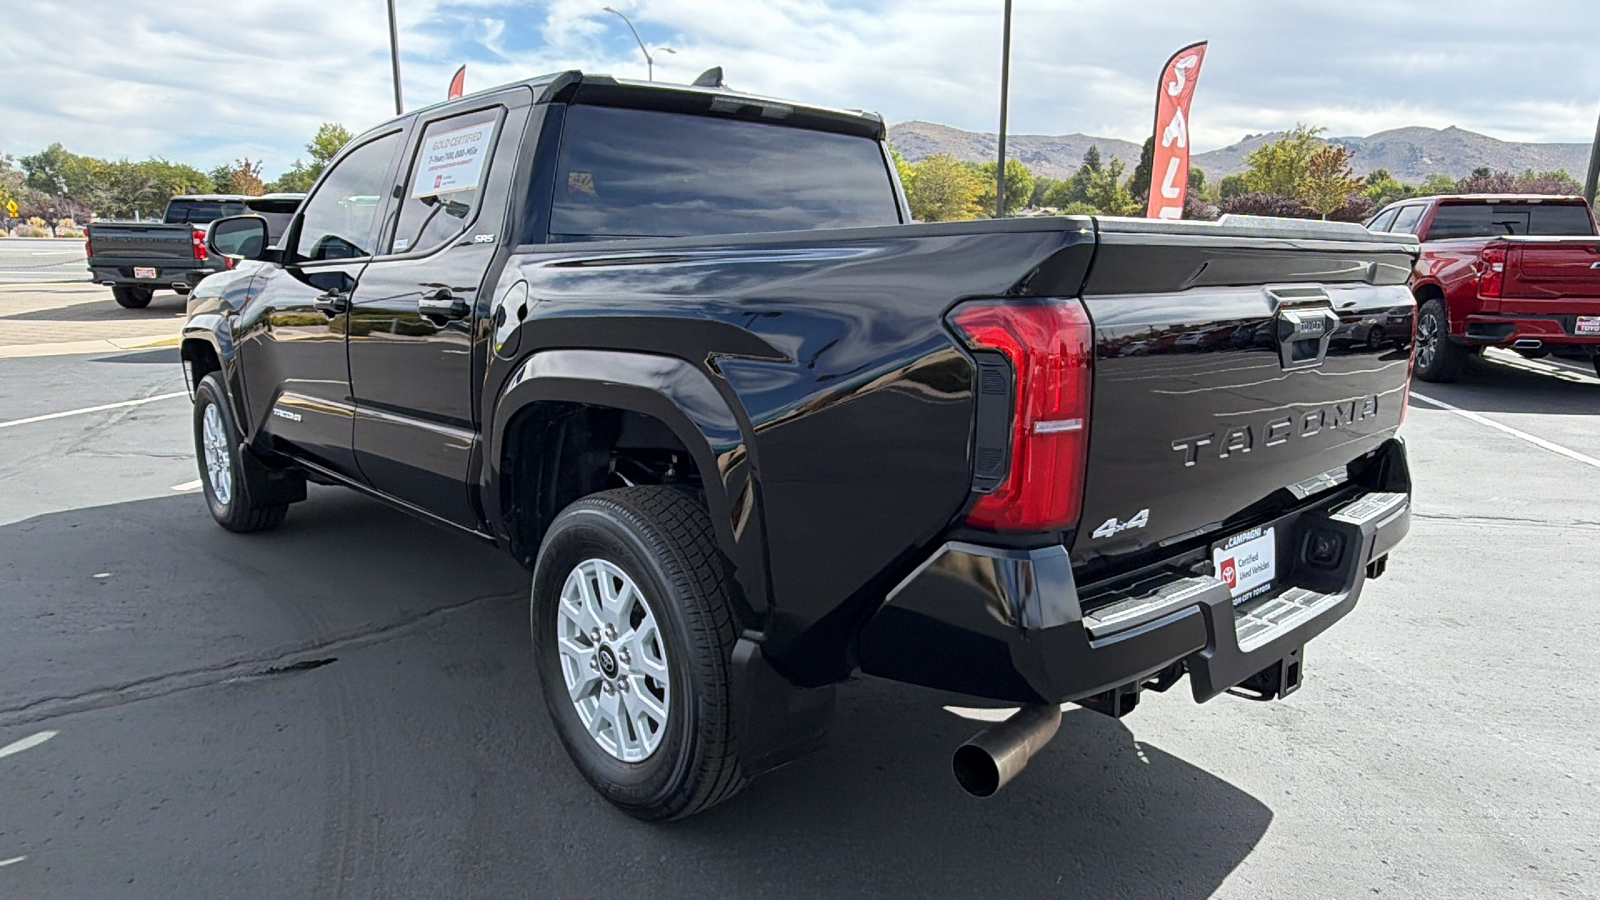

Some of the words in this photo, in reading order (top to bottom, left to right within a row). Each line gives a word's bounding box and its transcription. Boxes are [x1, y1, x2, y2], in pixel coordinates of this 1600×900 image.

[433, 139, 451, 151] GOLD
[450, 131, 482, 147] CERTIFIED
[273, 408, 301, 422] TACOMA
[1171, 393, 1379, 467] TACOMA
[1228, 527, 1261, 547] CAMPAGNI
[1238, 552, 1258, 567] Certified
[1240, 568, 1252, 580] Used
[1252, 561, 1270, 576] Vehicles
[1242, 591, 1253, 602] CITY
[1253, 583, 1271, 597] TOYOTA
